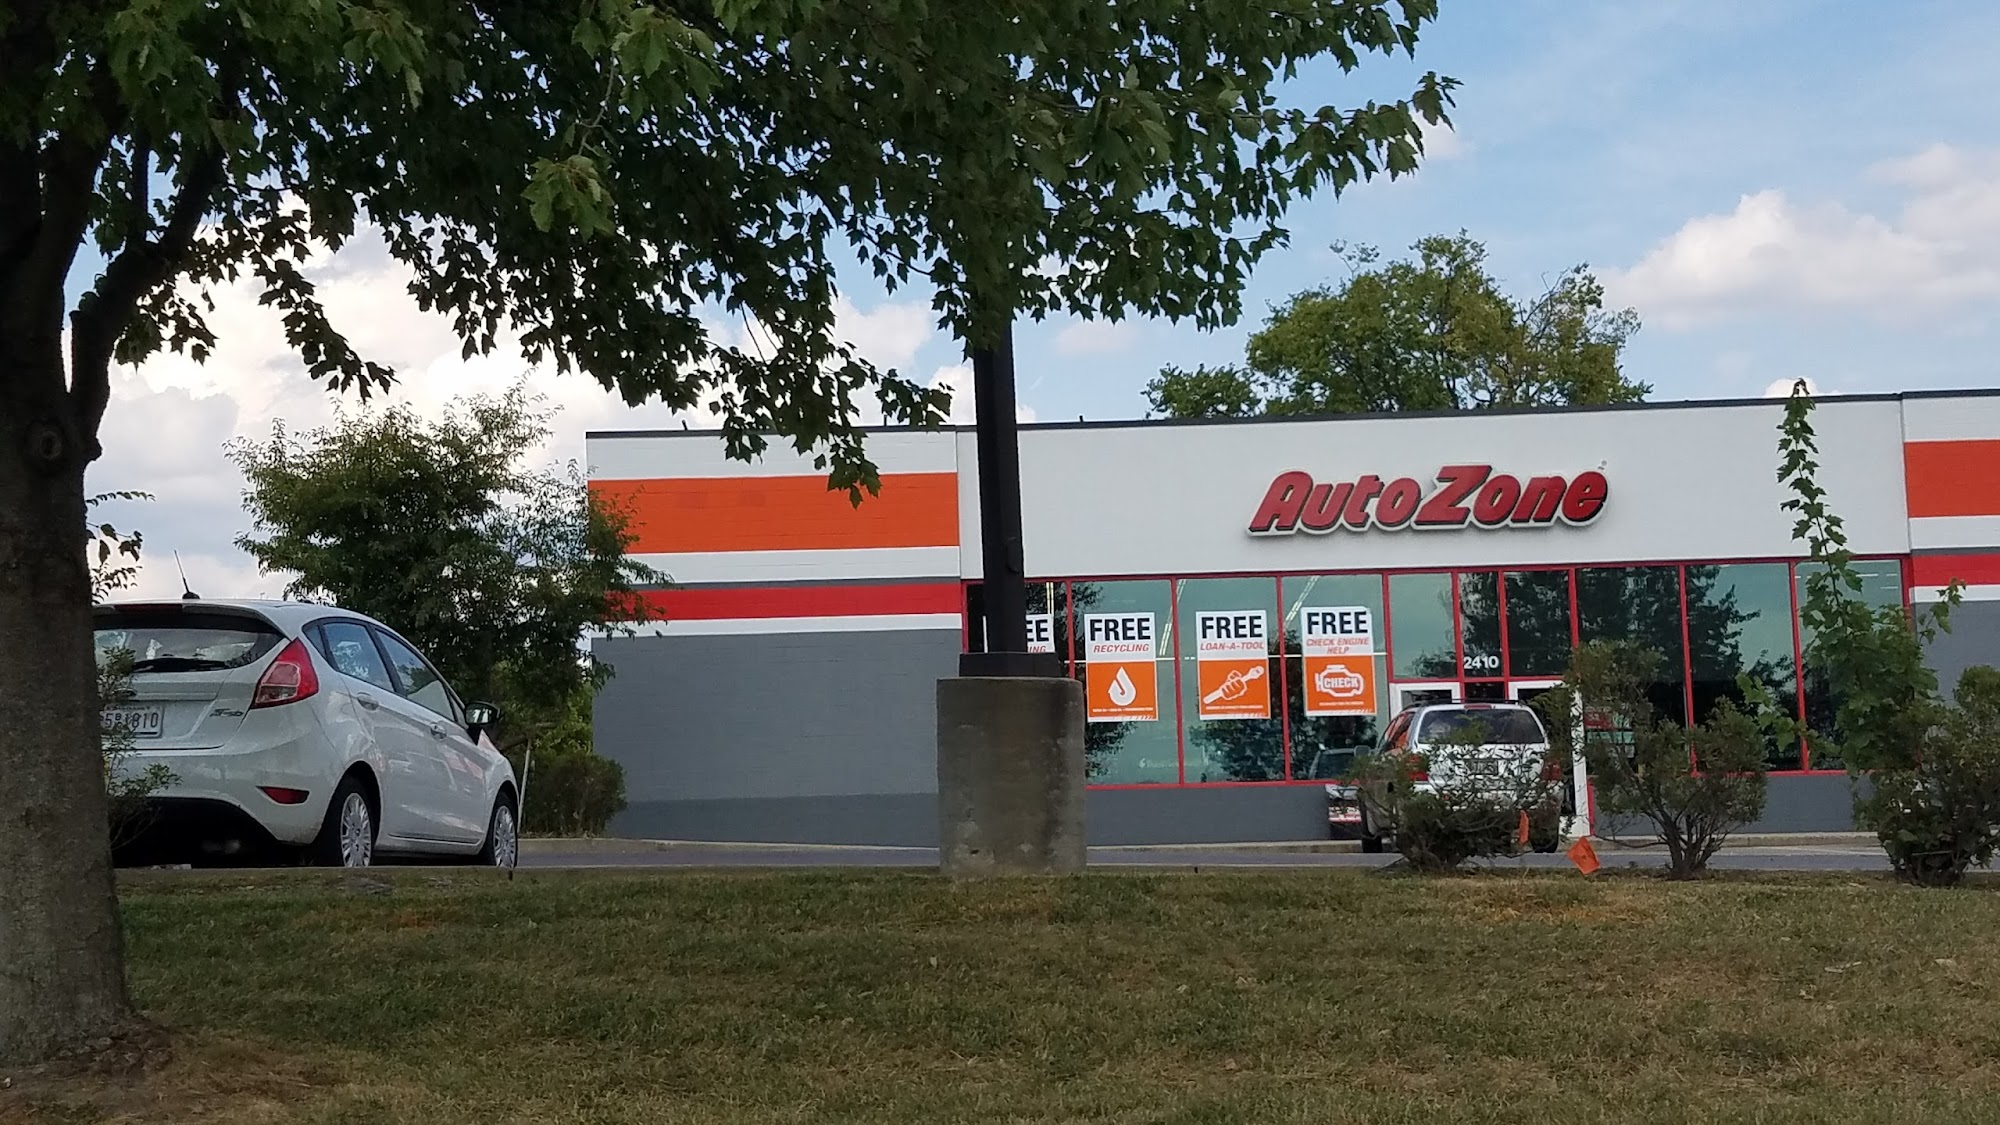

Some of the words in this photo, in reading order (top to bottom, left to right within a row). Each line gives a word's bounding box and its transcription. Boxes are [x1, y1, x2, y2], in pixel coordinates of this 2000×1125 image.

[1248, 464, 1608, 532] AutoZone
[1026, 619, 1049, 642] EE
[1090, 618, 1150, 641] FREE
[1201, 616, 1262, 639] FREE
[1307, 611, 1368, 634] FREE
[1093, 644, 1149, 653] RECYCLING
[1200, 642, 1264, 651] LOAN-A-TOOL
[1306, 638, 1335, 646] CHECK
[1337, 637, 1369, 645] ENGINE
[1463, 655, 1499, 669] 2410
[1323, 677, 1358, 689] CHECK
